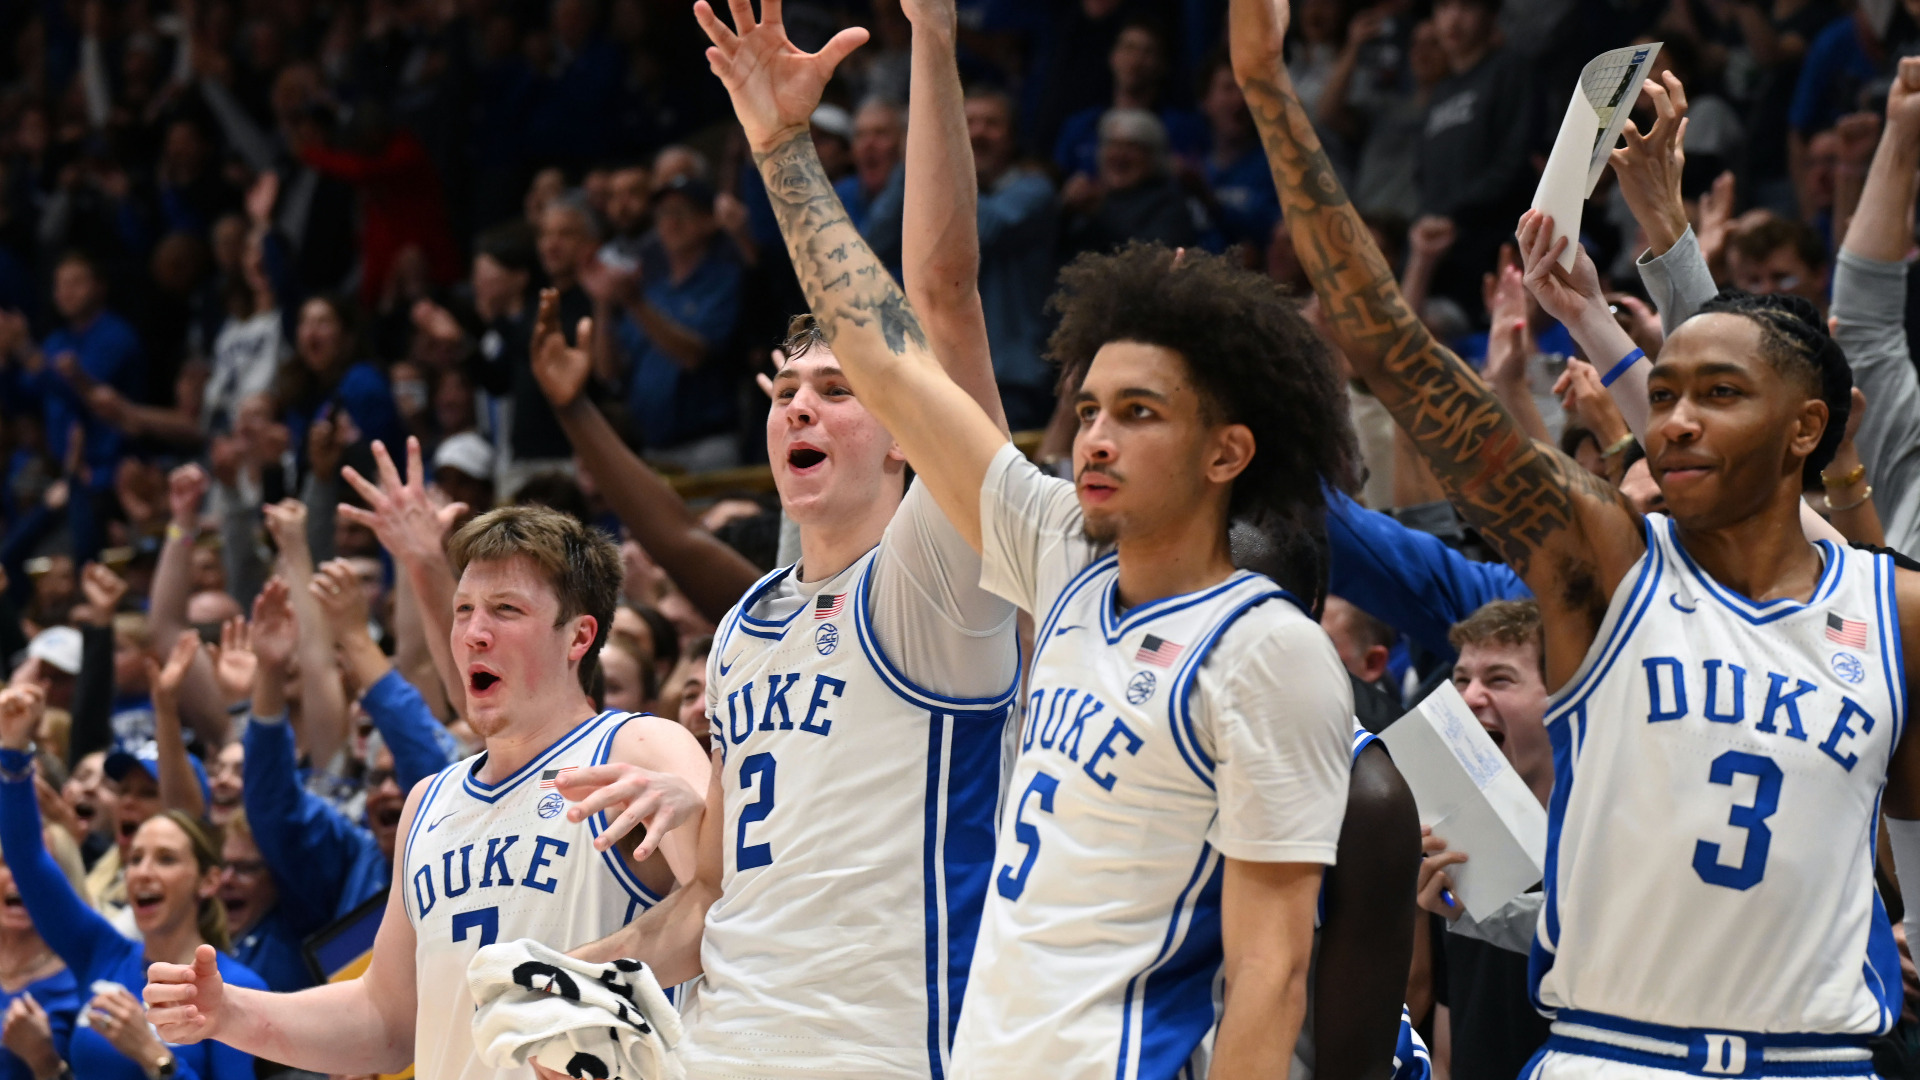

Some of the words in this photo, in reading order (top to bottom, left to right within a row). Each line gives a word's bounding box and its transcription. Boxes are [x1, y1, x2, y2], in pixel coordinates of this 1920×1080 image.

[1022, 687, 1145, 792] DUKE
[1642, 656, 1875, 772] DUKE
[736, 752, 777, 872] 2
[997, 770, 1060, 902] 5
[1692, 750, 1784, 891] 3
[414, 835, 570, 920] DUKE
[1701, 1034, 1747, 1075] D
